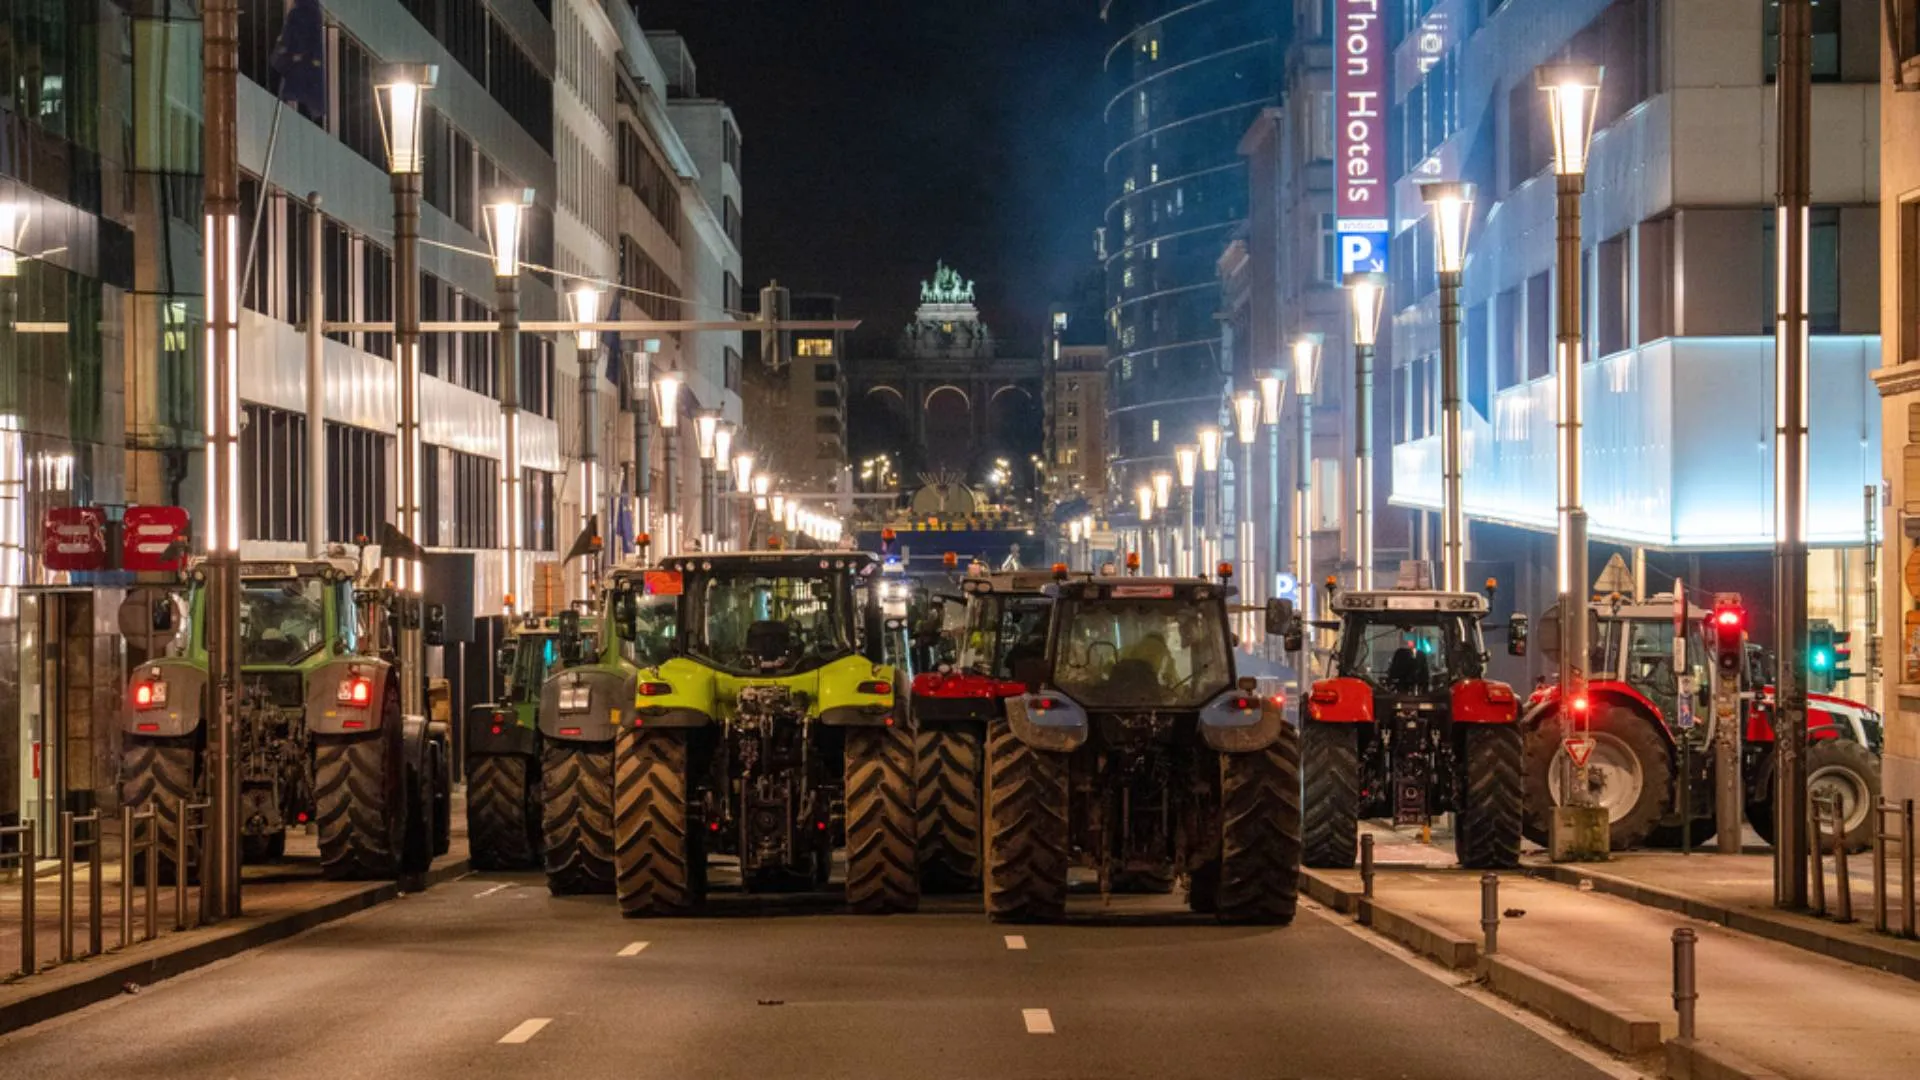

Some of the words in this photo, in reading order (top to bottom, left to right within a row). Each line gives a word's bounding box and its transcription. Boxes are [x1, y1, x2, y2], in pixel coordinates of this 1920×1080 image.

[1347, 91, 1378, 202] Hotels
[1342, 236, 1372, 273] P
[1276, 573, 1293, 599] P
